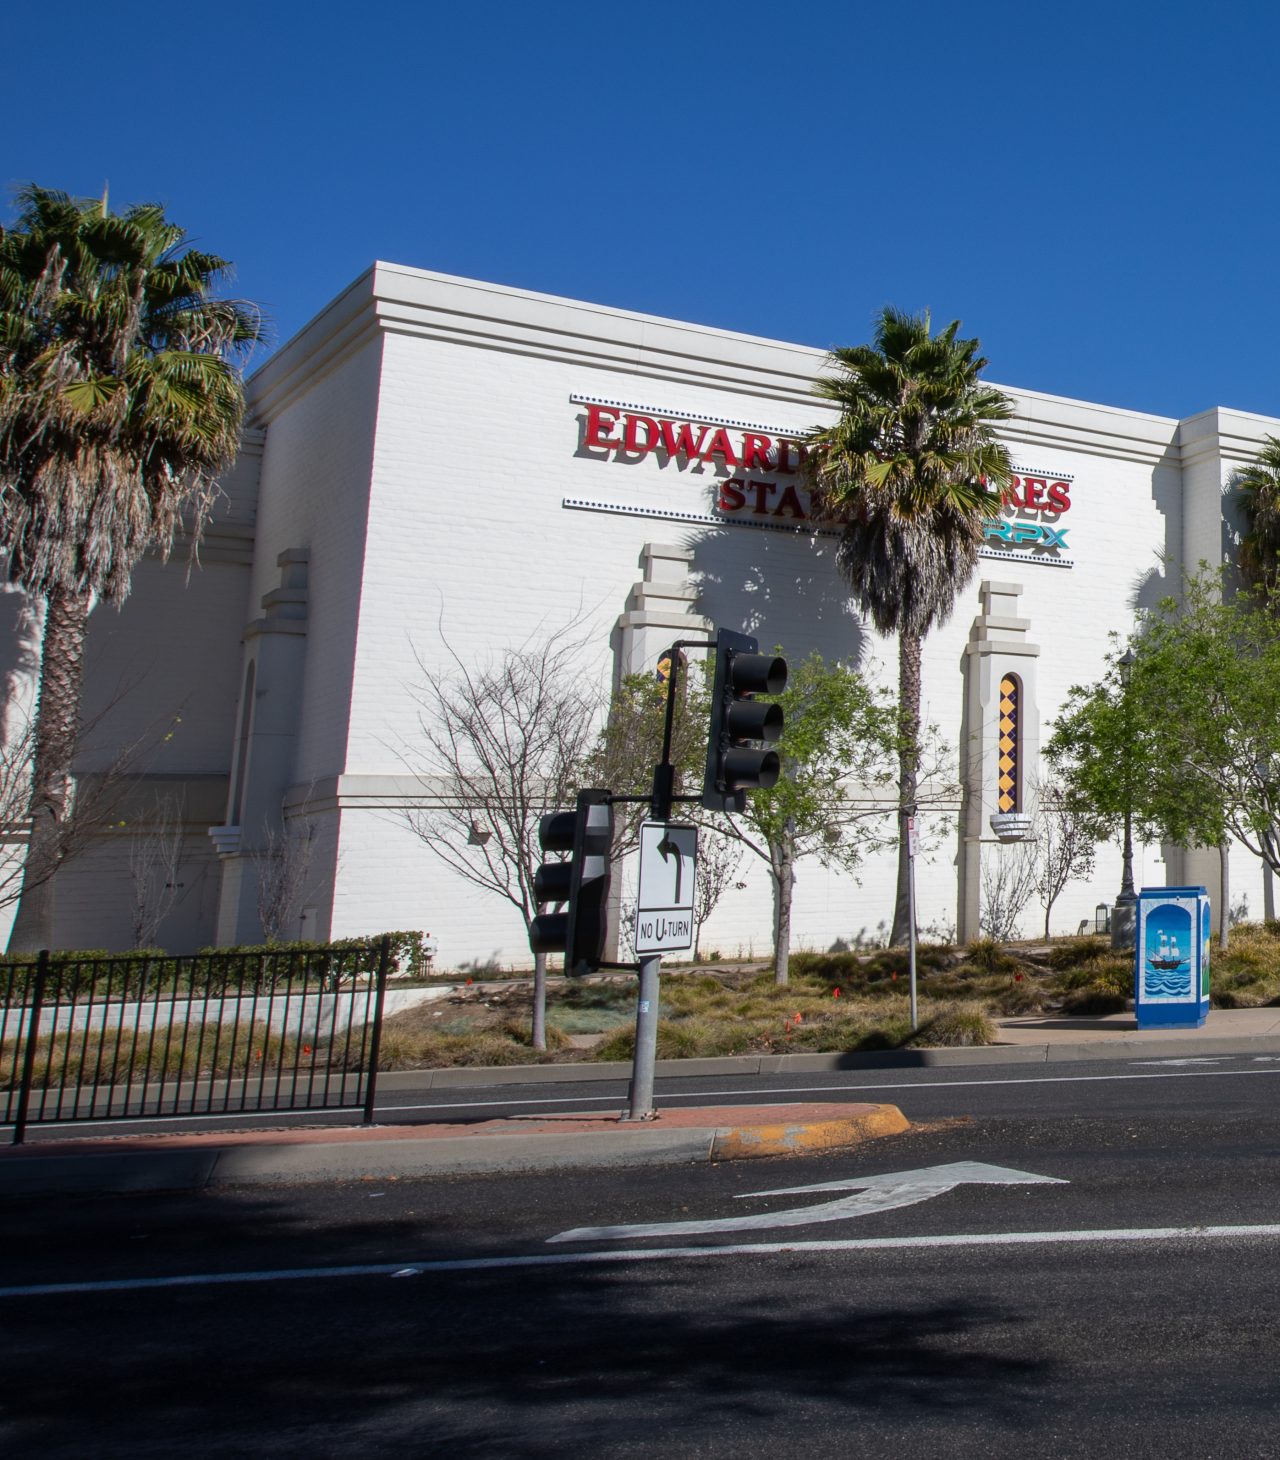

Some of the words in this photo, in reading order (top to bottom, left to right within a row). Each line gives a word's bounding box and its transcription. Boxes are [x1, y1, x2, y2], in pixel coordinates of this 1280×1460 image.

[585, 403, 832, 477] EDWARD
[981, 520, 1071, 549] RPX
[641, 922, 653, 939] NO
